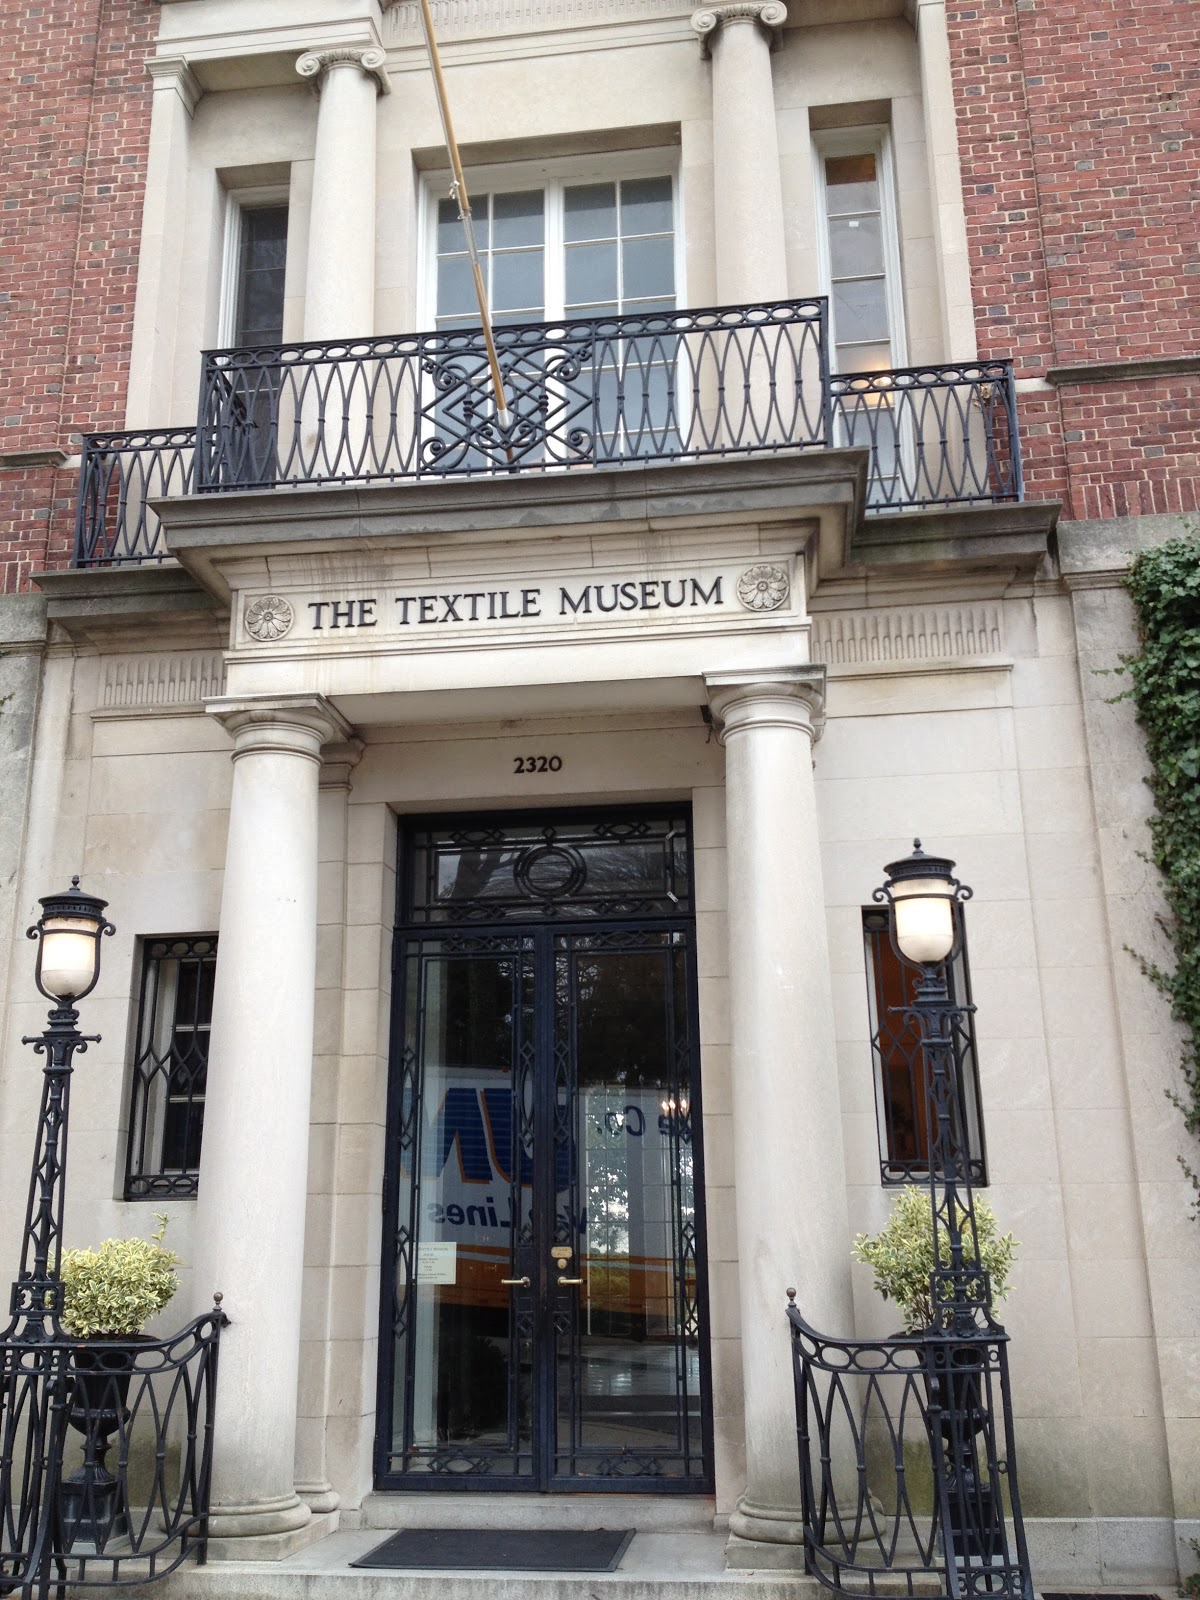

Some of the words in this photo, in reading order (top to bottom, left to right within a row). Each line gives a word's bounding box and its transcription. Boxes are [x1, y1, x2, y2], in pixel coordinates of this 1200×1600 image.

[308, 599, 377, 630] THE
[396, 588, 541, 625] TEXTILE
[559, 576, 724, 615] MUSEUM
[513, 756, 563, 775] 2320
